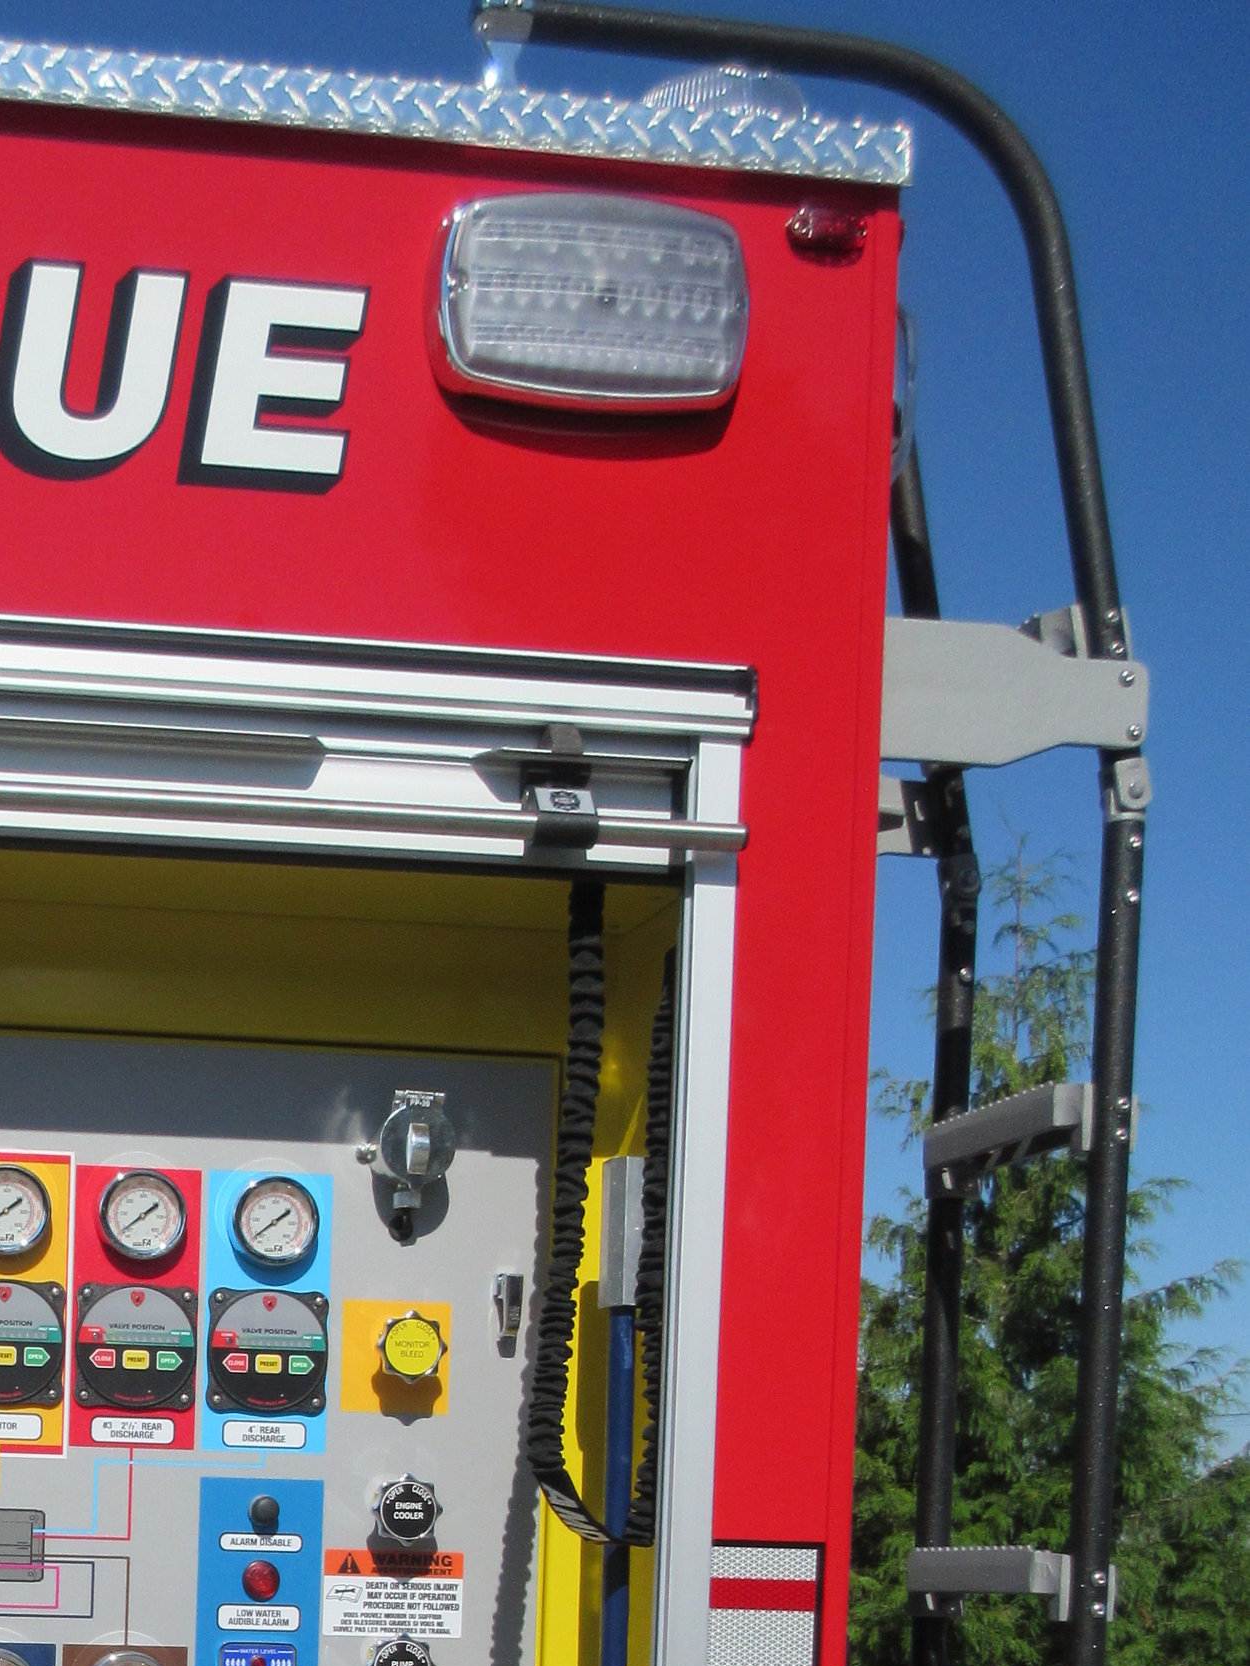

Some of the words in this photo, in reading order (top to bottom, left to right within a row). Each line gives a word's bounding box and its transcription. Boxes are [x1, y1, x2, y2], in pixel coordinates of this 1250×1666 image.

[392, 1322, 407, 1336] OPEN
[416, 1322, 434, 1337] CLOSE
[141, 1423, 162, 1431] REAR
[259, 1426, 280, 1434] REAR
[110, 1430, 154, 1439] DISCHARGE
[242, 1434, 286, 1443] DISCHARGE
[388, 1486, 404, 1501] OPEN
[412, 1485, 430, 1502] CLOSE
[395, 1502, 423, 1510] ENGINE
[393, 1511, 424, 1520] COOLER
[229, 1538, 257, 1546] ALARM
[260, 1538, 292, 1547] DISABLE
[373, 1554, 453, 1567] WARNING
[366, 1582, 388, 1590] DEATH
[390, 1582, 399, 1590] OR
[402, 1582, 431, 1590] SERIOUS
[433, 1583, 459, 1591] INJURY
[367, 1591, 382, 1600] MAY
[384, 1592, 408, 1600] OCCUR
[410, 1592, 416, 1600] IF
[418, 1592, 456, 1601] OPERATION
[363, 1601, 405, 1610] PROCEDURE
[407, 1602, 421, 1610] NOT
[423, 1602, 459, 1611] FOLLOWED
[236, 1609, 253, 1617] LOW
[255, 1610, 281, 1618] WATER
[228, 1617, 261, 1625] AUDIBLE
[262, 1618, 289, 1626] ALARM
[381, 1645, 398, 1659] OPEN
[405, 1644, 424, 1660] CLOSE
